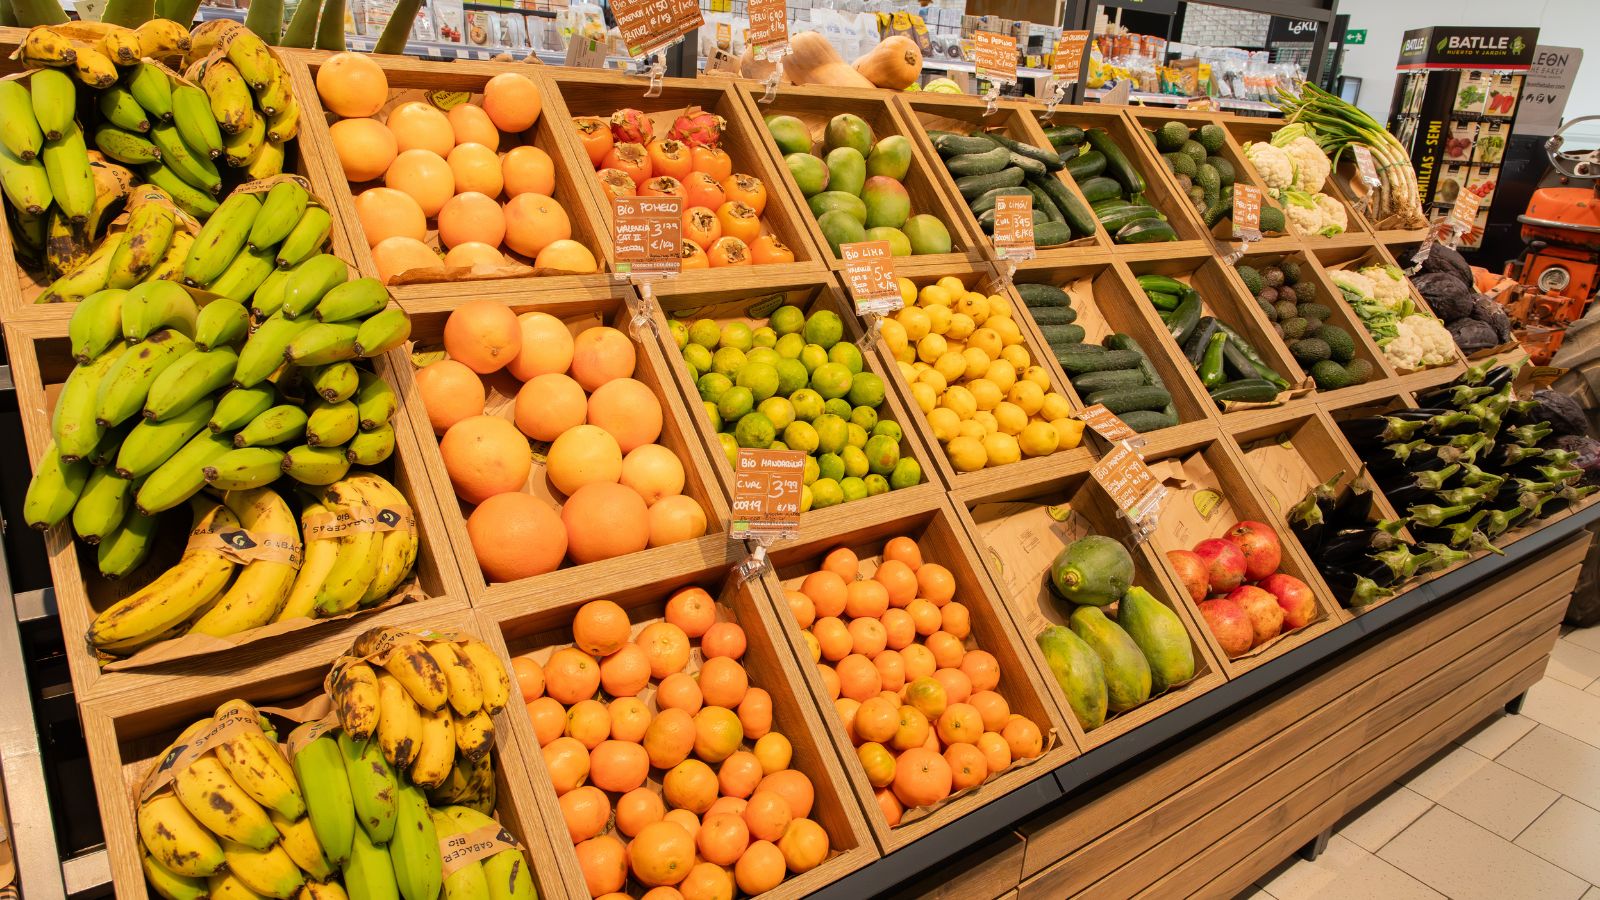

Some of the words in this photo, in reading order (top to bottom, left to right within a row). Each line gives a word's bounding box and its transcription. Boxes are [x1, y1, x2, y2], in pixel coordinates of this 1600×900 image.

[1404, 37, 1425, 51] BATLLE
[1448, 36, 1510, 49] BATLLE
[1532, 52, 1570, 67] EON
[640, 202, 679, 213] POMELO
[616, 223, 650, 233] VALENCIA
[761, 458, 804, 468] MANDARINA
[768, 480, 798, 499] 3'99
[443, 841, 494, 863] GABACER
